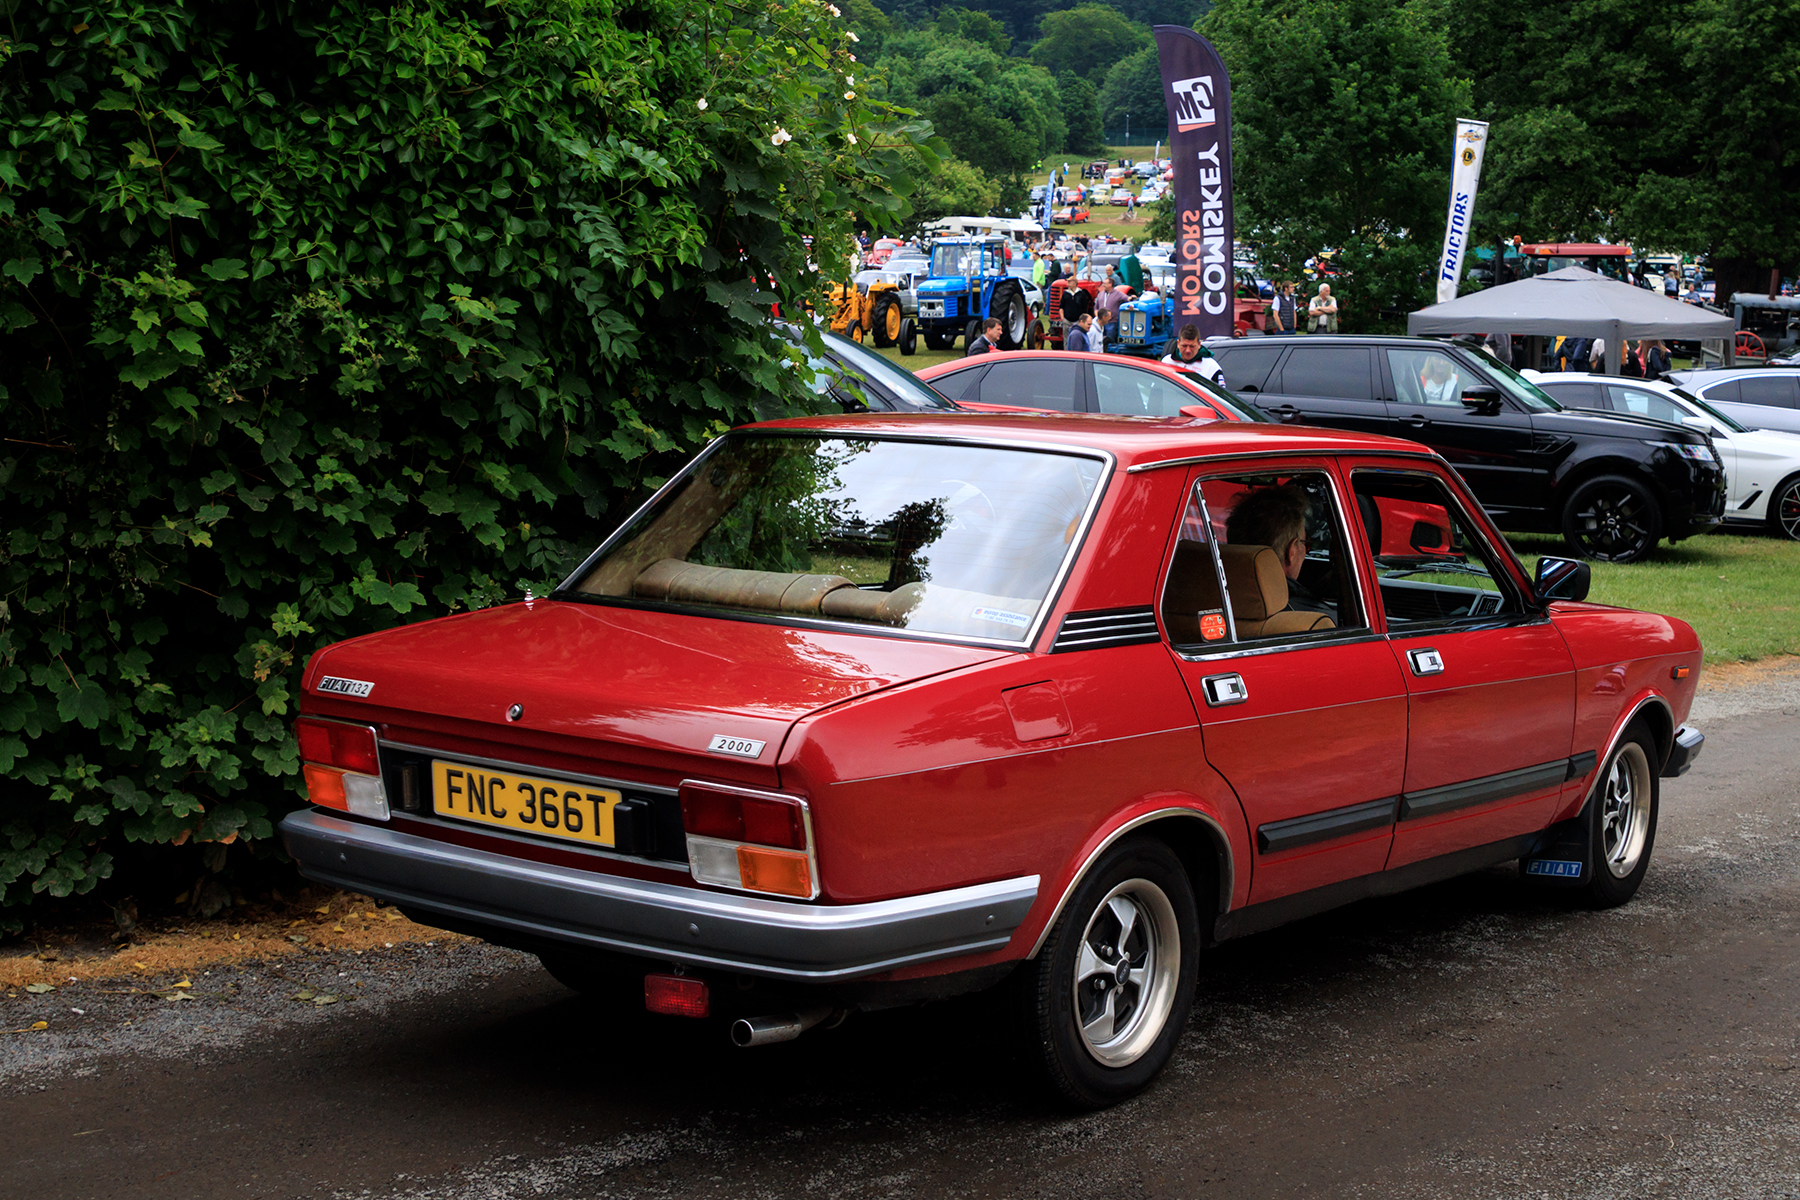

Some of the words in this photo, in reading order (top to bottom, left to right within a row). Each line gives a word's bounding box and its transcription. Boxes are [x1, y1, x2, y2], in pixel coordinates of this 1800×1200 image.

[1441, 192, 1469, 282] TRACTORS
[999, 612, 1027, 622] assistance
[320, 678, 351, 692] FIAT
[350, 682, 369, 694] 132
[717, 739, 752, 752] 2000
[446, 768, 507, 819] FNC
[517, 782, 606, 837] 366T
[1530, 861, 1579, 875] FIAT
